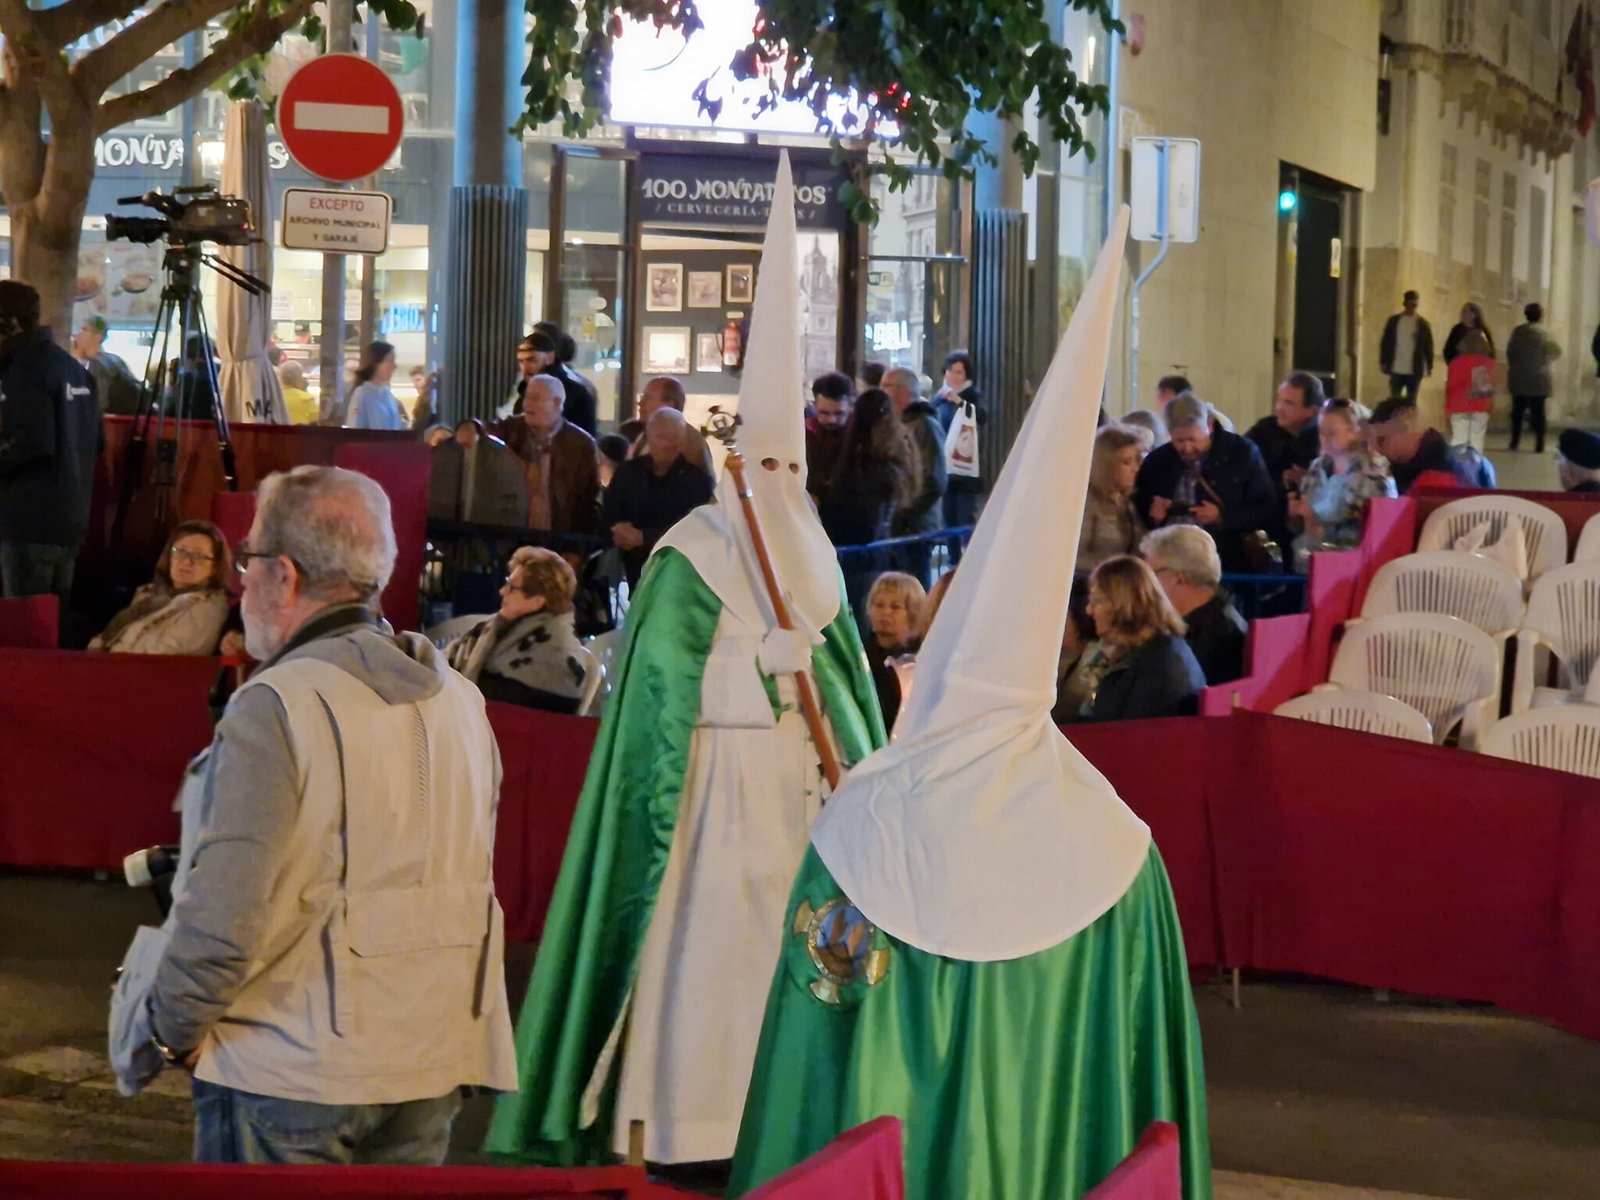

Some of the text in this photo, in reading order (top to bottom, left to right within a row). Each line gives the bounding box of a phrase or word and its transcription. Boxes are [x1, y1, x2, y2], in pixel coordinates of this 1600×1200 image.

[642, 178, 826, 205] 100 MONTADOS
[309, 197, 365, 212] EXCEPTO
[289, 215, 382, 230] ARCHIVO MUNICIPAL
[313, 233, 359, 243] Y GARAJE
